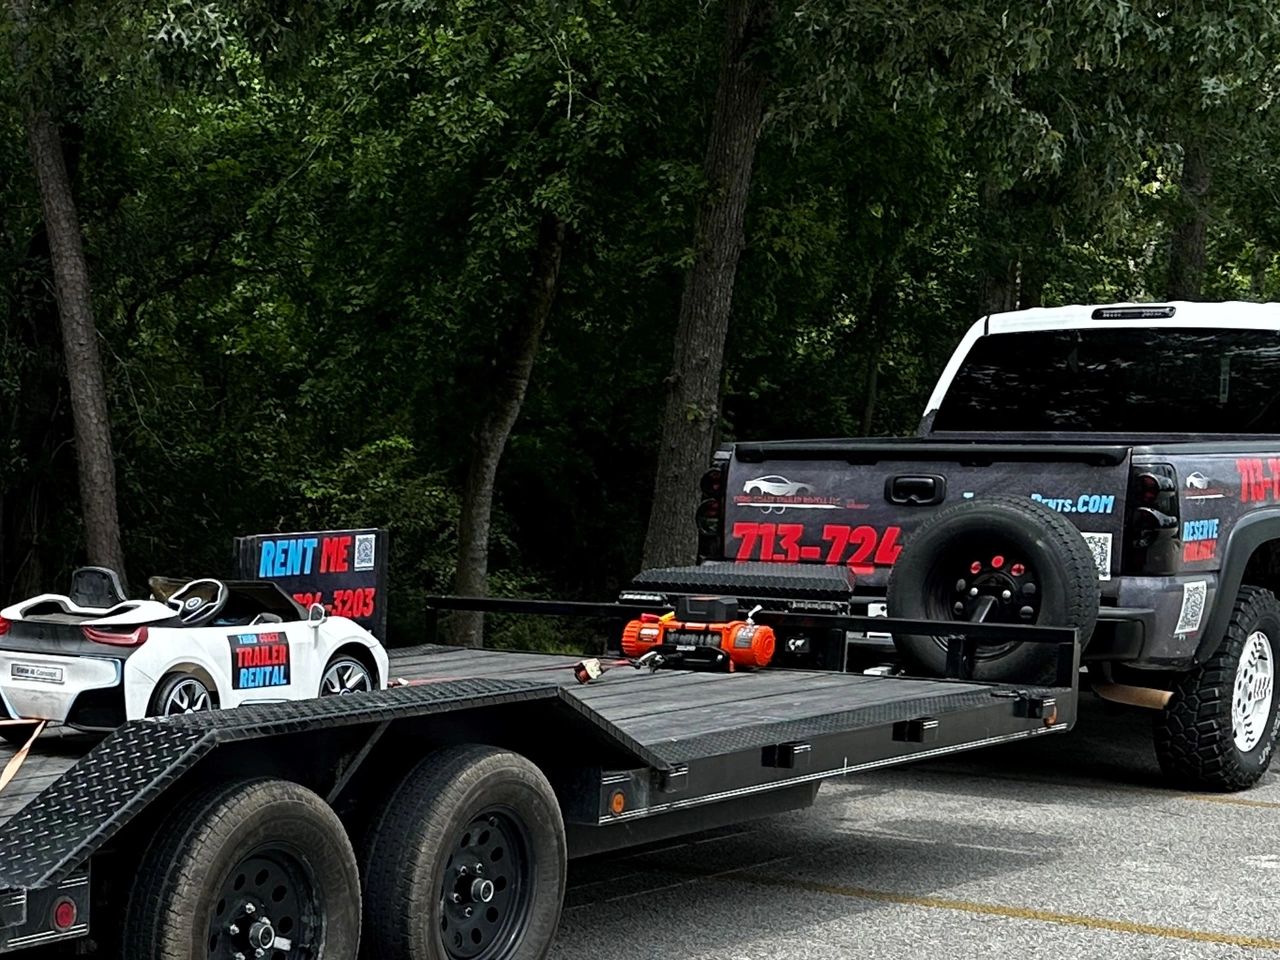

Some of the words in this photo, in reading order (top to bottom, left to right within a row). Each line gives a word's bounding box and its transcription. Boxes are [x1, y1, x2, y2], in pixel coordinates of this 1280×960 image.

[259, 538, 318, 578] RENT
[320, 535, 352, 574] ME
[235, 644, 287, 668] TRAILER
[239, 665, 287, 688] RENTAL
